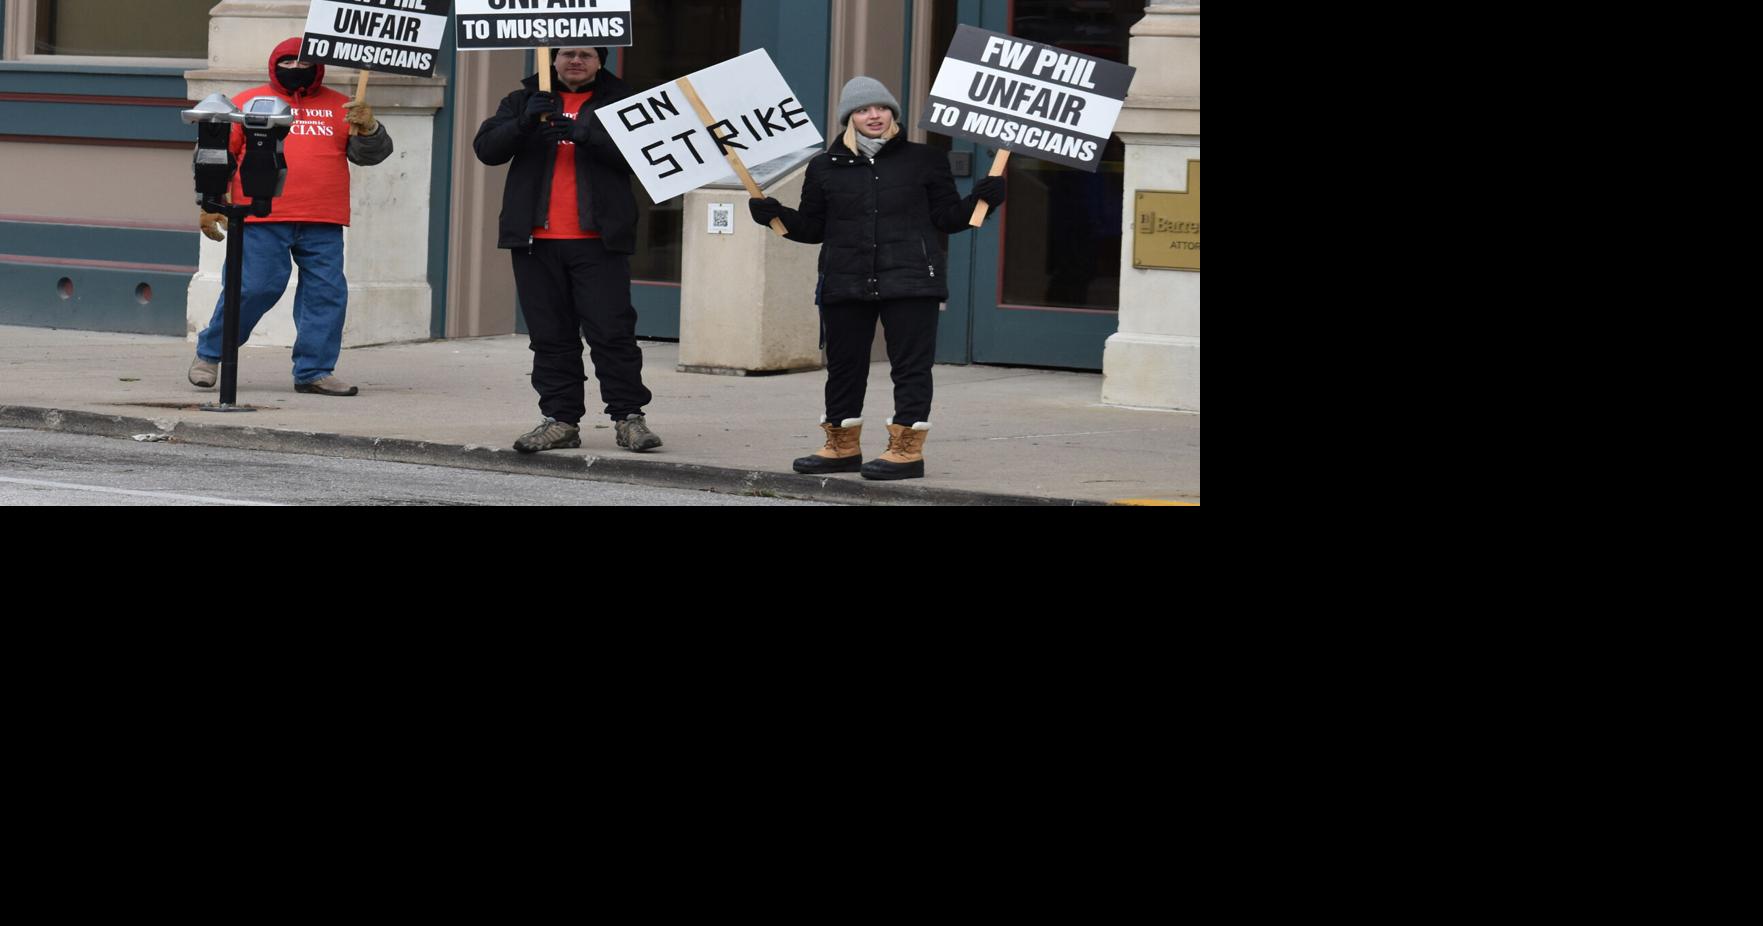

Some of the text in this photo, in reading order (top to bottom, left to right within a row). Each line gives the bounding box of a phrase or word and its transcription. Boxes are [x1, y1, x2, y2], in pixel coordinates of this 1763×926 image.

[333, 7, 421, 43] UNFAIR
[462, 17, 625, 39] TO MUSICIANS
[307, 37, 433, 71] TO MUSICIANS
[980, 35, 1096, 89] FW PHIL
[305, 108, 333, 118] YOUR
[617, 90, 680, 132] ON
[968, 71, 1086, 127] UNFAIR
[289, 124, 334, 137] CIANS
[640, 97, 809, 179] STRIKE
[929, 102, 1098, 162] TO MUSICIANS
